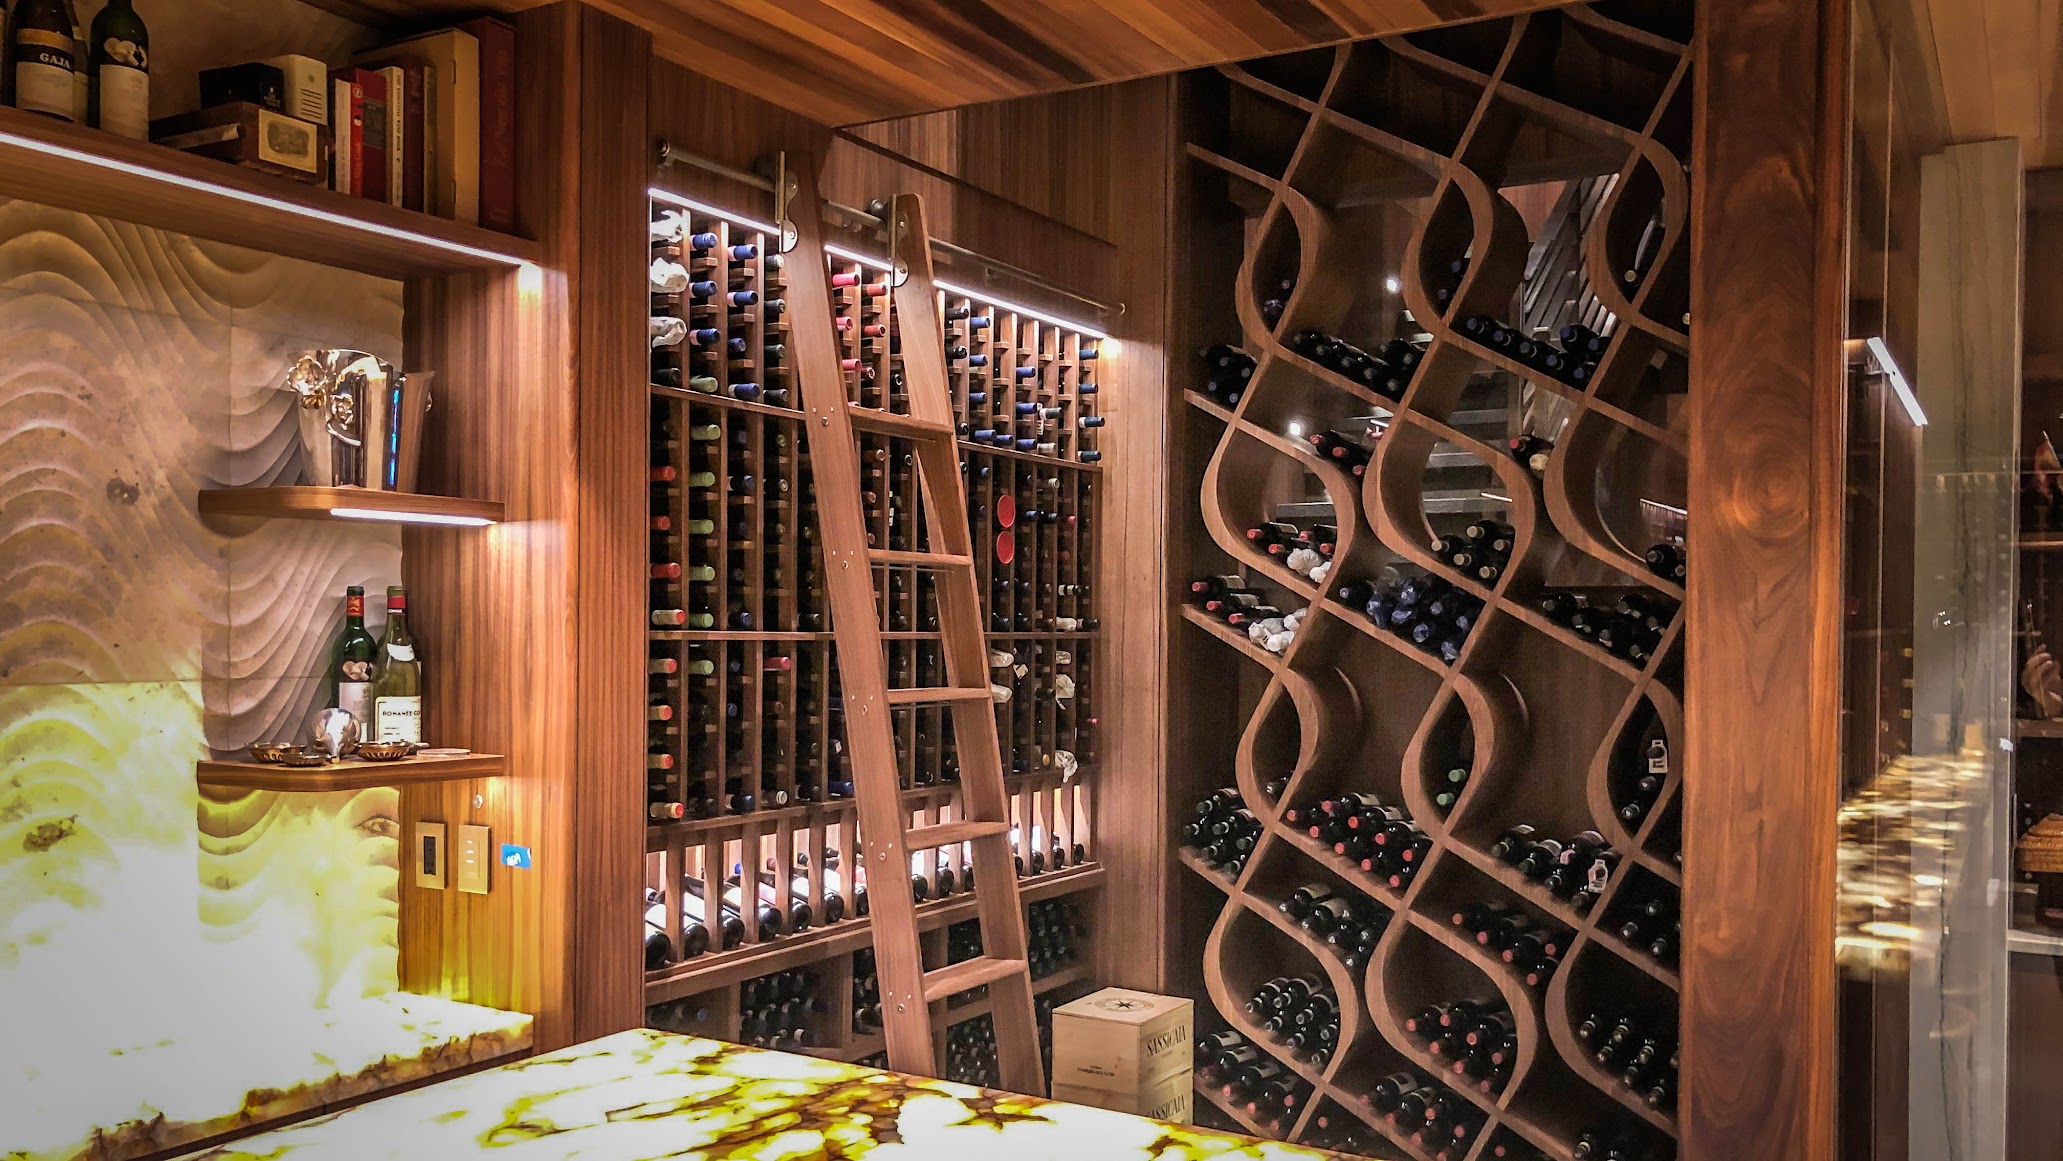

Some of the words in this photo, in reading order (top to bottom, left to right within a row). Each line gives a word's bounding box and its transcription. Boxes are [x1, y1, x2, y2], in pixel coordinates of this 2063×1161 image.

[40, 53, 71, 69] GAJA
[1147, 1025, 1186, 1058] SASSICAIA
[1149, 1094, 1185, 1119] ASSICAIA
